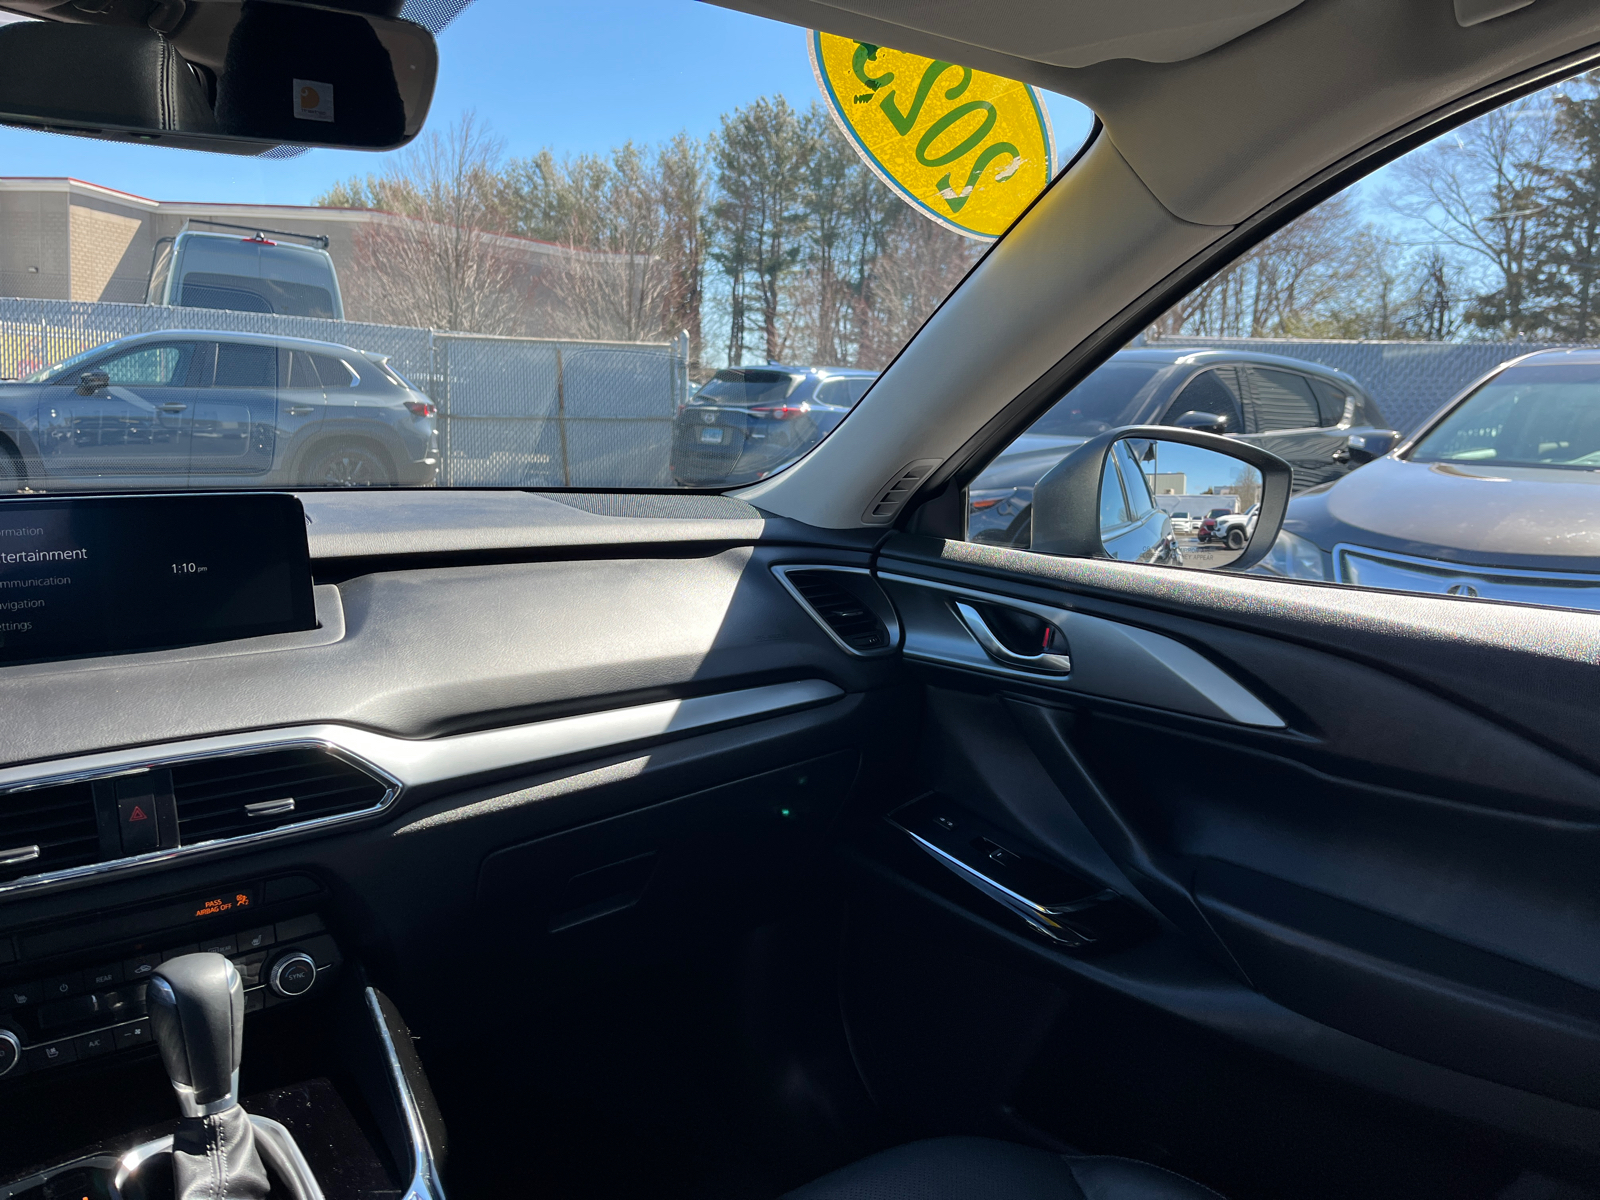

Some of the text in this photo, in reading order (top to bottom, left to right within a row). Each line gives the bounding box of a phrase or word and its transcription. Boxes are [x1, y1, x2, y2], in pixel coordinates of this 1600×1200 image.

[0, 548, 88, 564] tertainment
[171, 562, 196, 574] 1:10
[204, 898, 223, 908] PASS
[196, 902, 232, 917] AIRBAG OFF
[95, 974, 113, 984] REAR
[288, 971, 306, 981] SYNC
[88, 1039, 101, 1048] A/C
